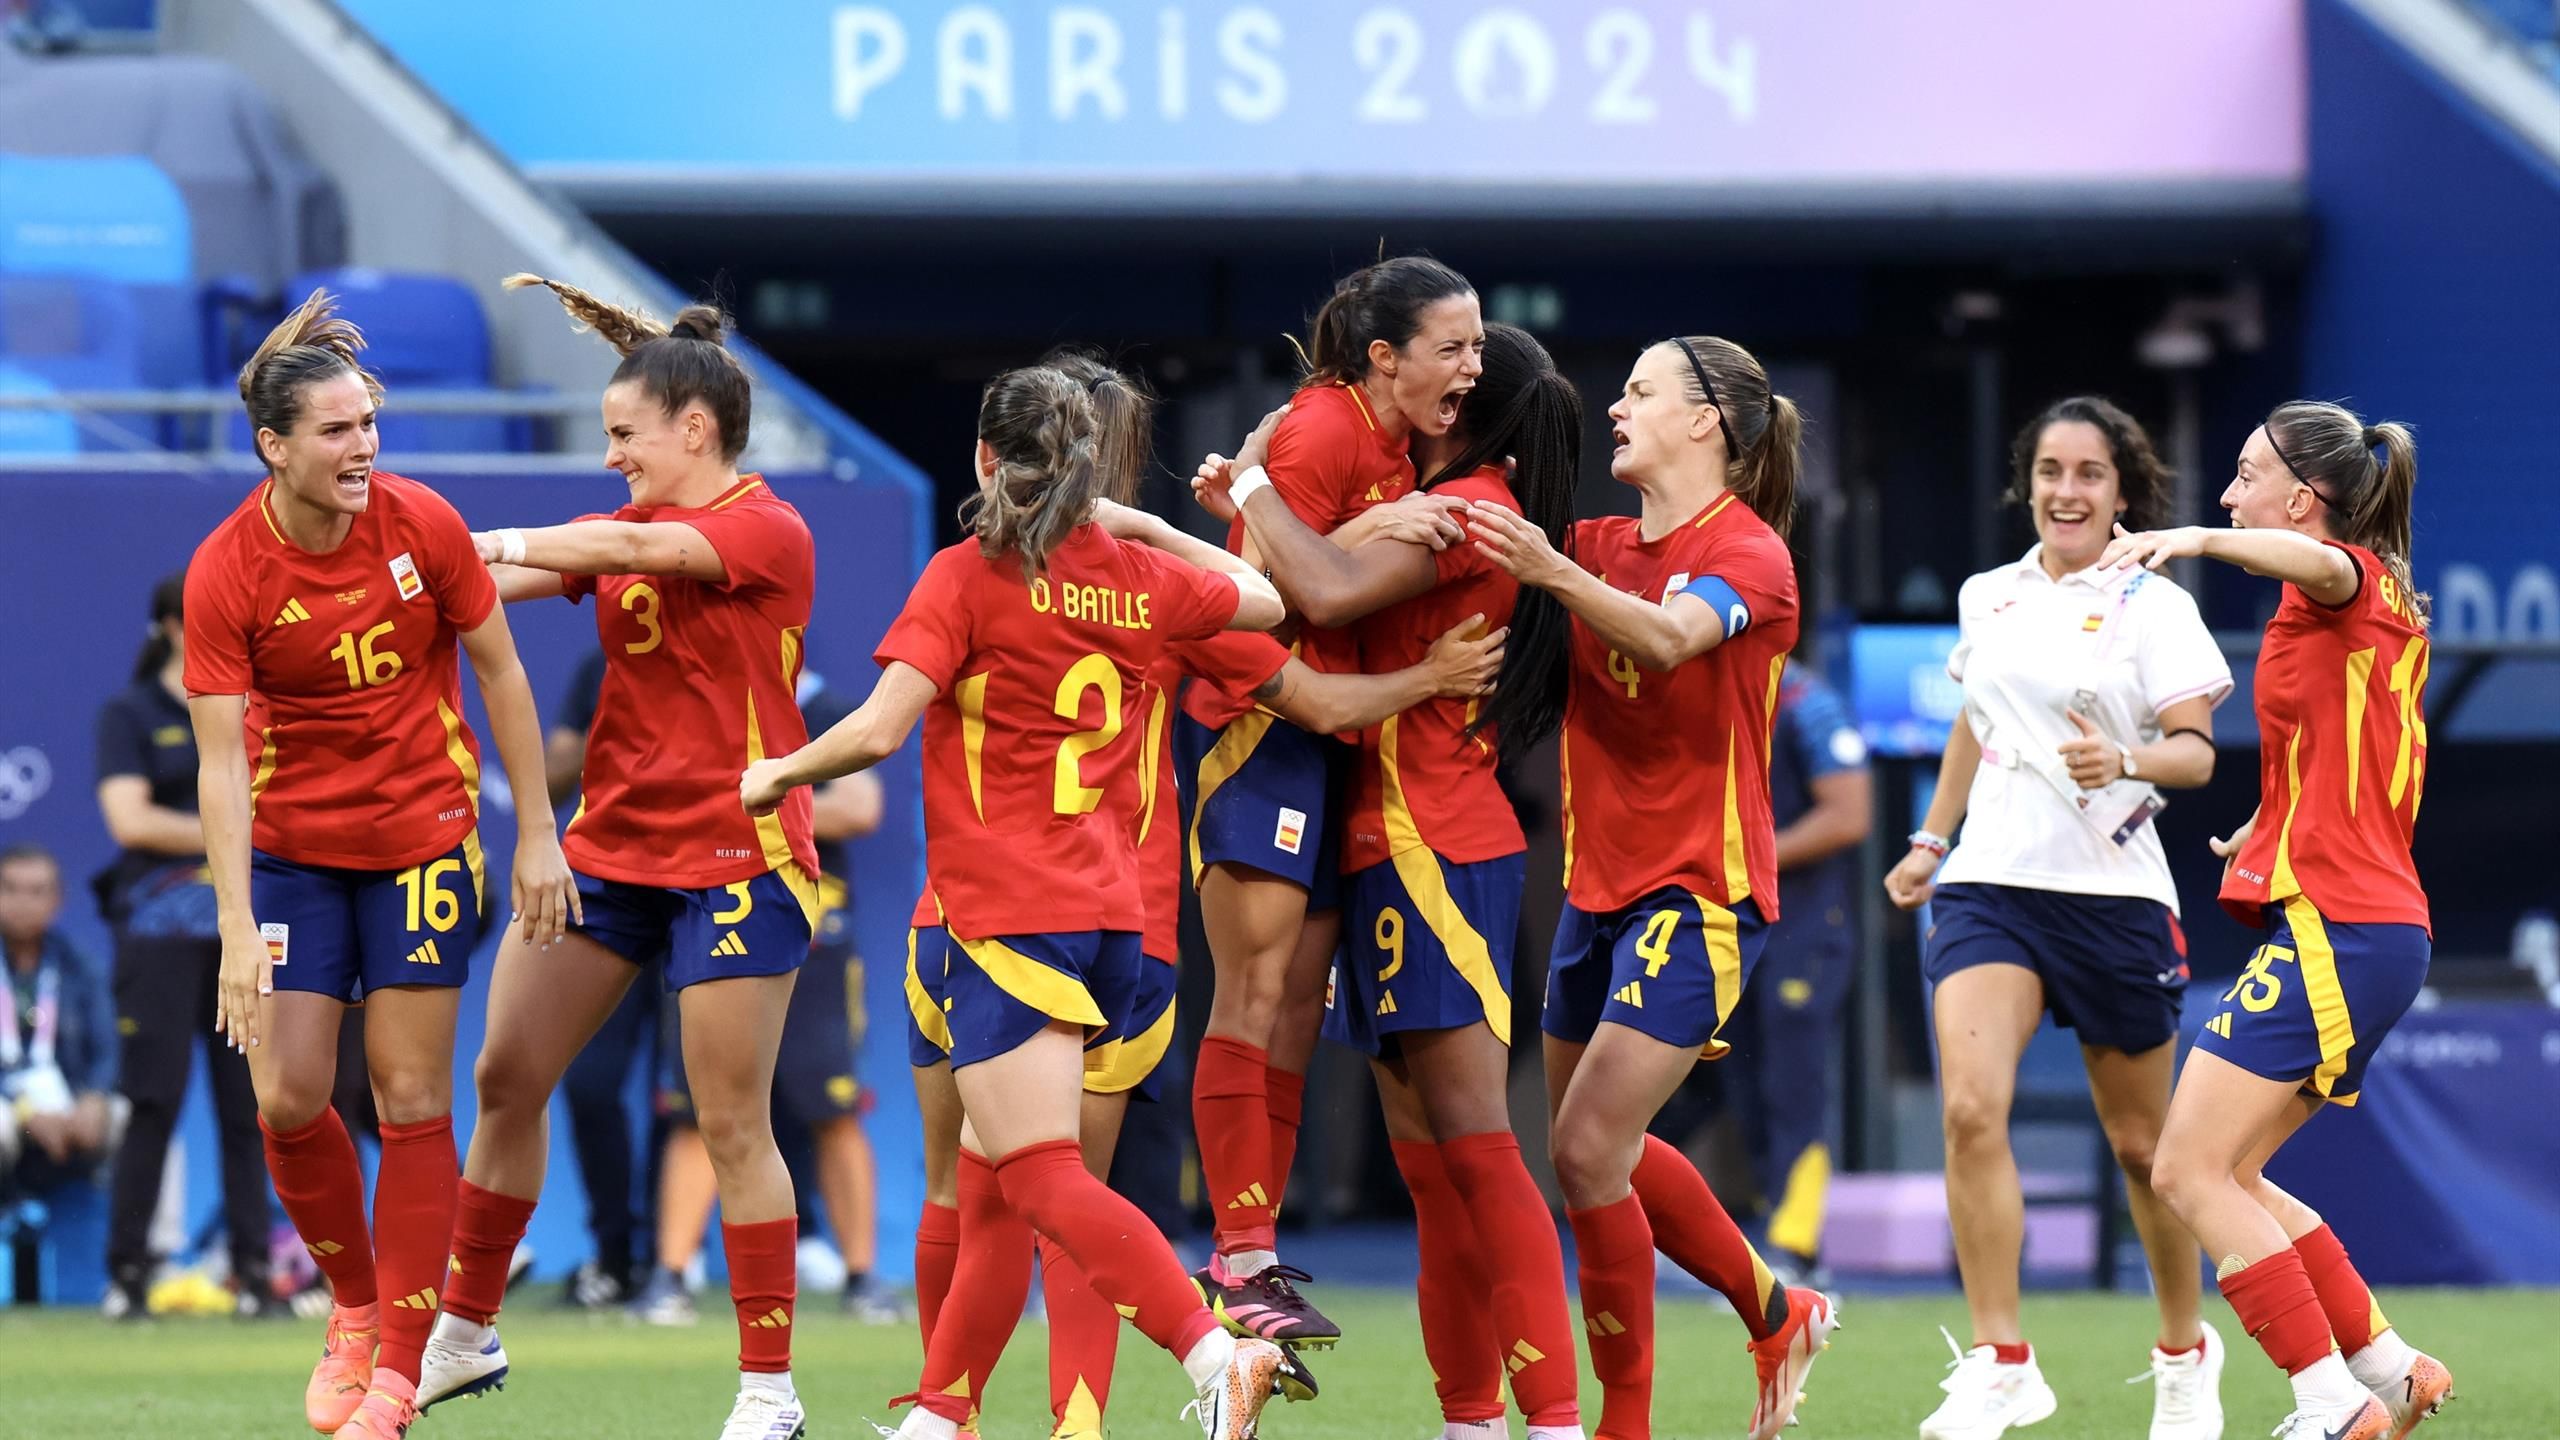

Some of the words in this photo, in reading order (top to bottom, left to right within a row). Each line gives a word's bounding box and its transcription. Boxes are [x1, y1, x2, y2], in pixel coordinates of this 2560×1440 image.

[831, 5, 1289, 122] PARIS
[1352, 5, 1759, 122] 2024
[621, 582, 663, 655] 3
[1062, 582, 1152, 630] BATLLE
[330, 620, 404, 689] 16
[1608, 649, 1641, 698] 4
[1053, 652, 1123, 815] 2
[715, 848, 752, 859] HEAT.RDY
[396, 858, 461, 933] 16
[1375, 906, 1404, 982] 9
[1635, 909, 1682, 979] 4
